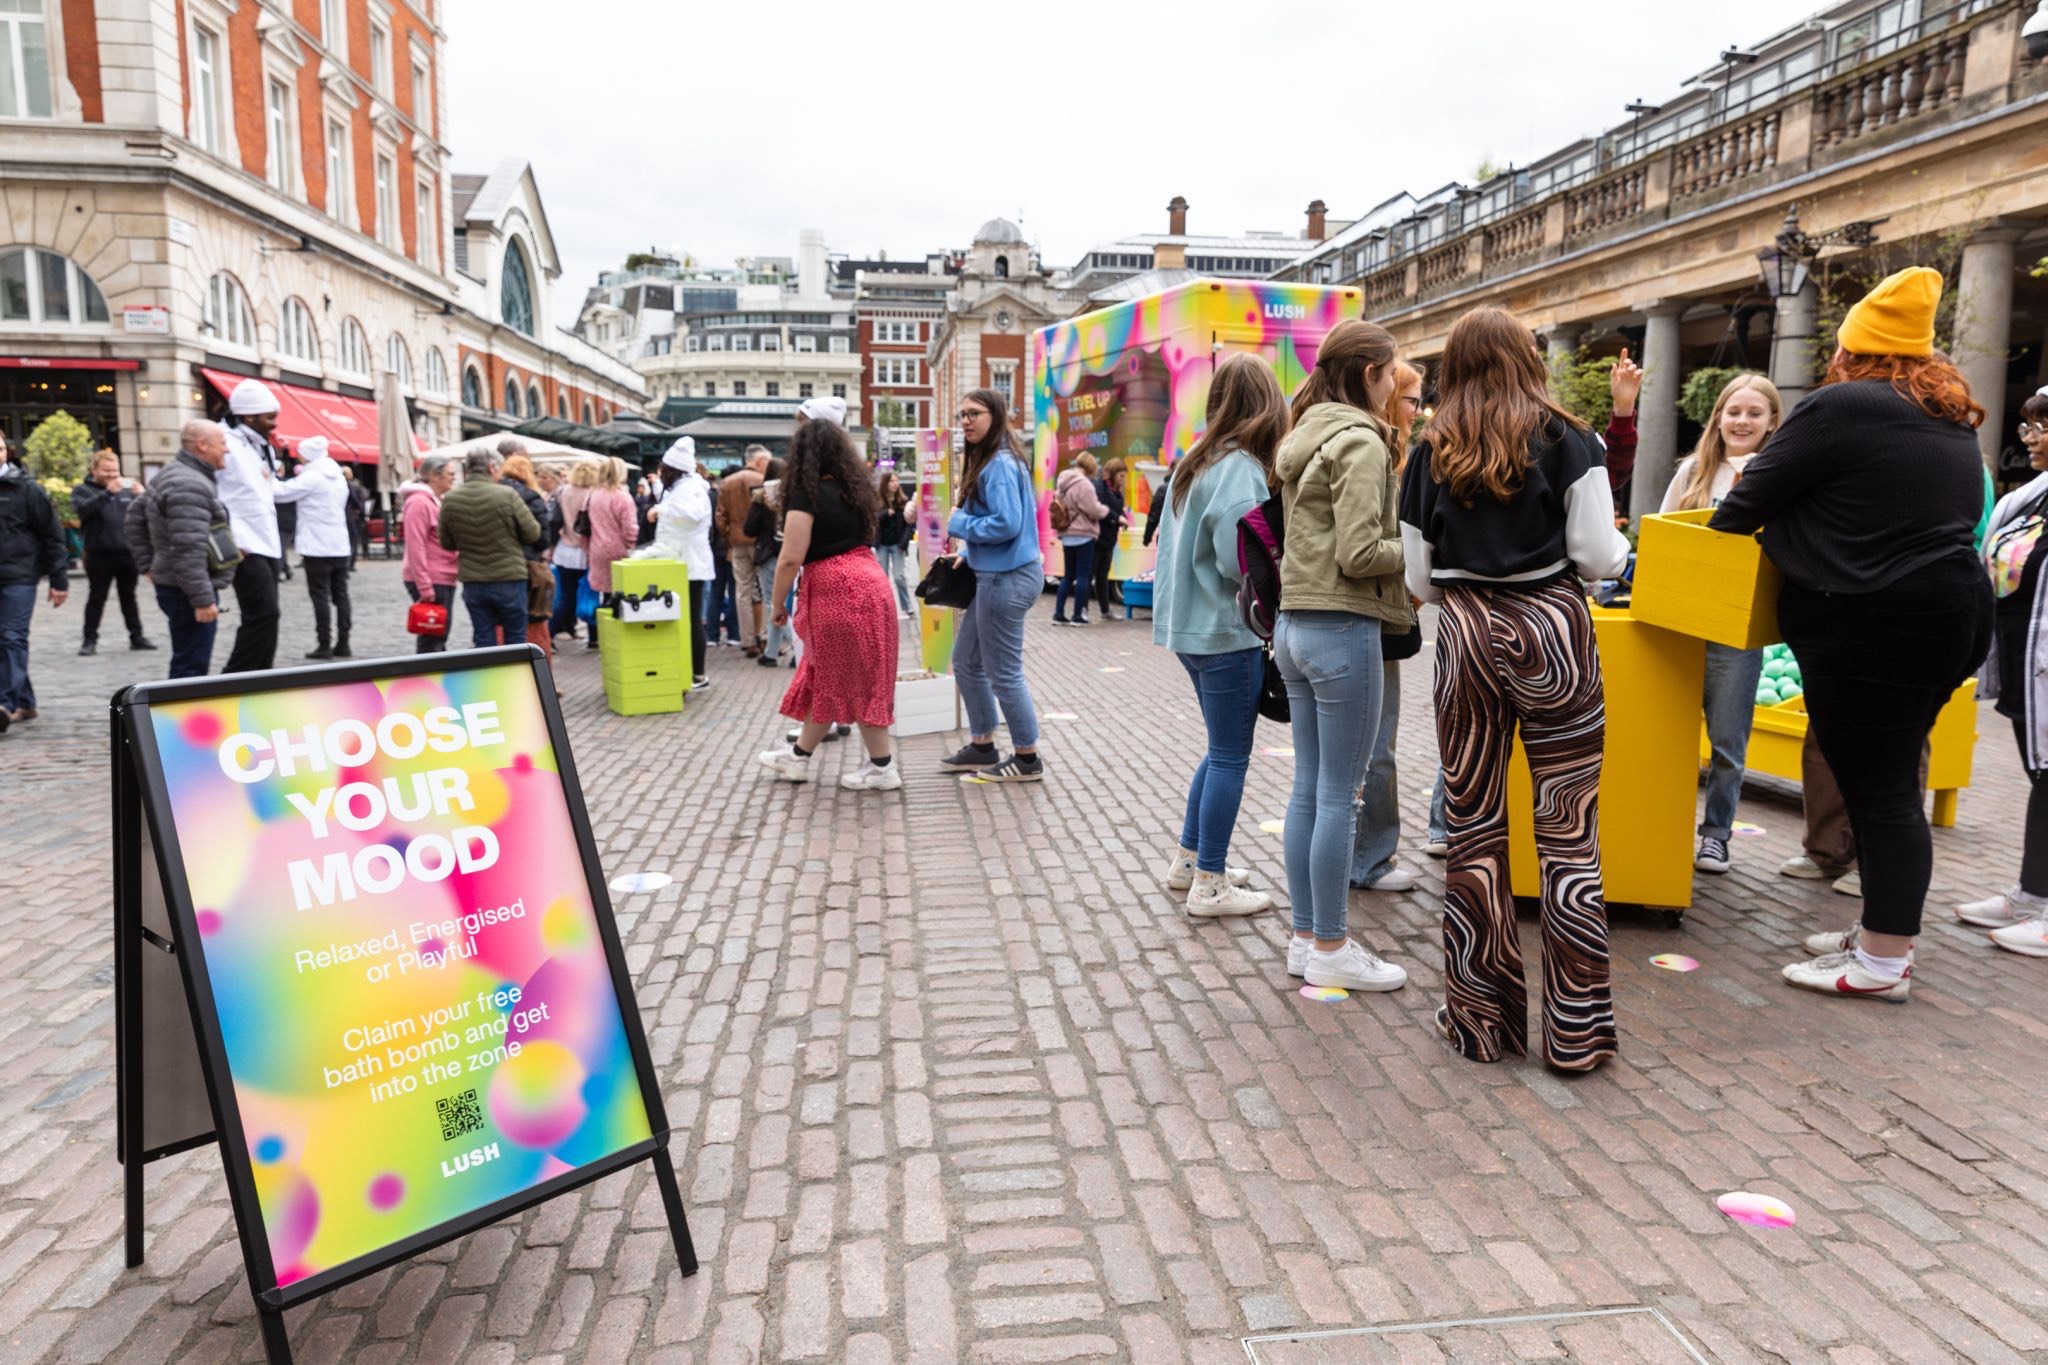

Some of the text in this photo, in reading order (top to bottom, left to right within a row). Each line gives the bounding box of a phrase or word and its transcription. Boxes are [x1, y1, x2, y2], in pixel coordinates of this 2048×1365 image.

[1265, 303, 1305, 319] LUSH
[1068, 391, 1110, 413] LEVEL UP
[1068, 414, 1093, 431] YOUR
[1068, 431, 1108, 450] BATHING
[218, 700, 505, 783] CHOOSE
[285, 767, 476, 838] YOUR
[287, 825, 500, 911] MOOD
[295, 897, 526, 973] Relaxed, Energised
[366, 935, 478, 983] or Playful
[323, 1002, 550, 1089] bath bomb and get
[343, 987, 522, 1052] Claim your free
[370, 1040, 522, 1104] into the zone
[440, 1142, 500, 1178] LUSH
